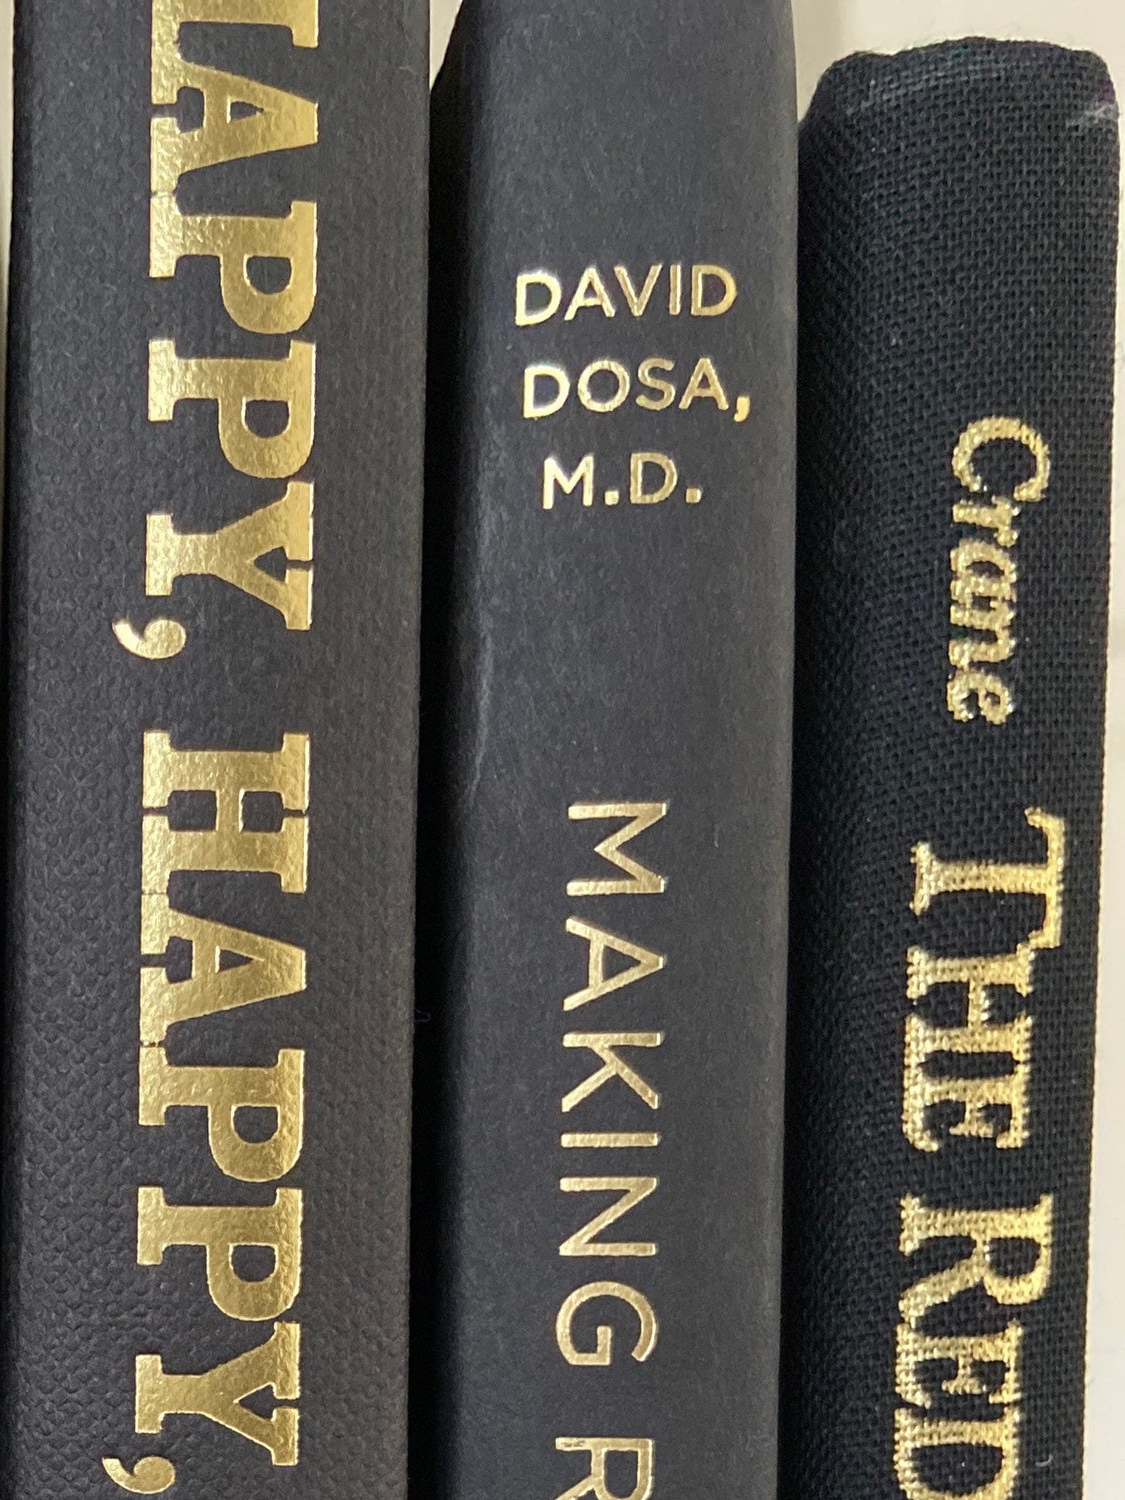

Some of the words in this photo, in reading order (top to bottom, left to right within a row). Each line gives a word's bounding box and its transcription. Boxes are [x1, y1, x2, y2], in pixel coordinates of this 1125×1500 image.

[515, 261, 737, 326] DAVID
[523, 356, 750, 422] DOSA,
[543, 452, 702, 509] M.D.
[947, 417, 1049, 724] Crane
[103, 730, 310, 1494] HAPPY,
[556, 801, 668, 1365] MAKING
[902, 808, 1065, 1152] THE
